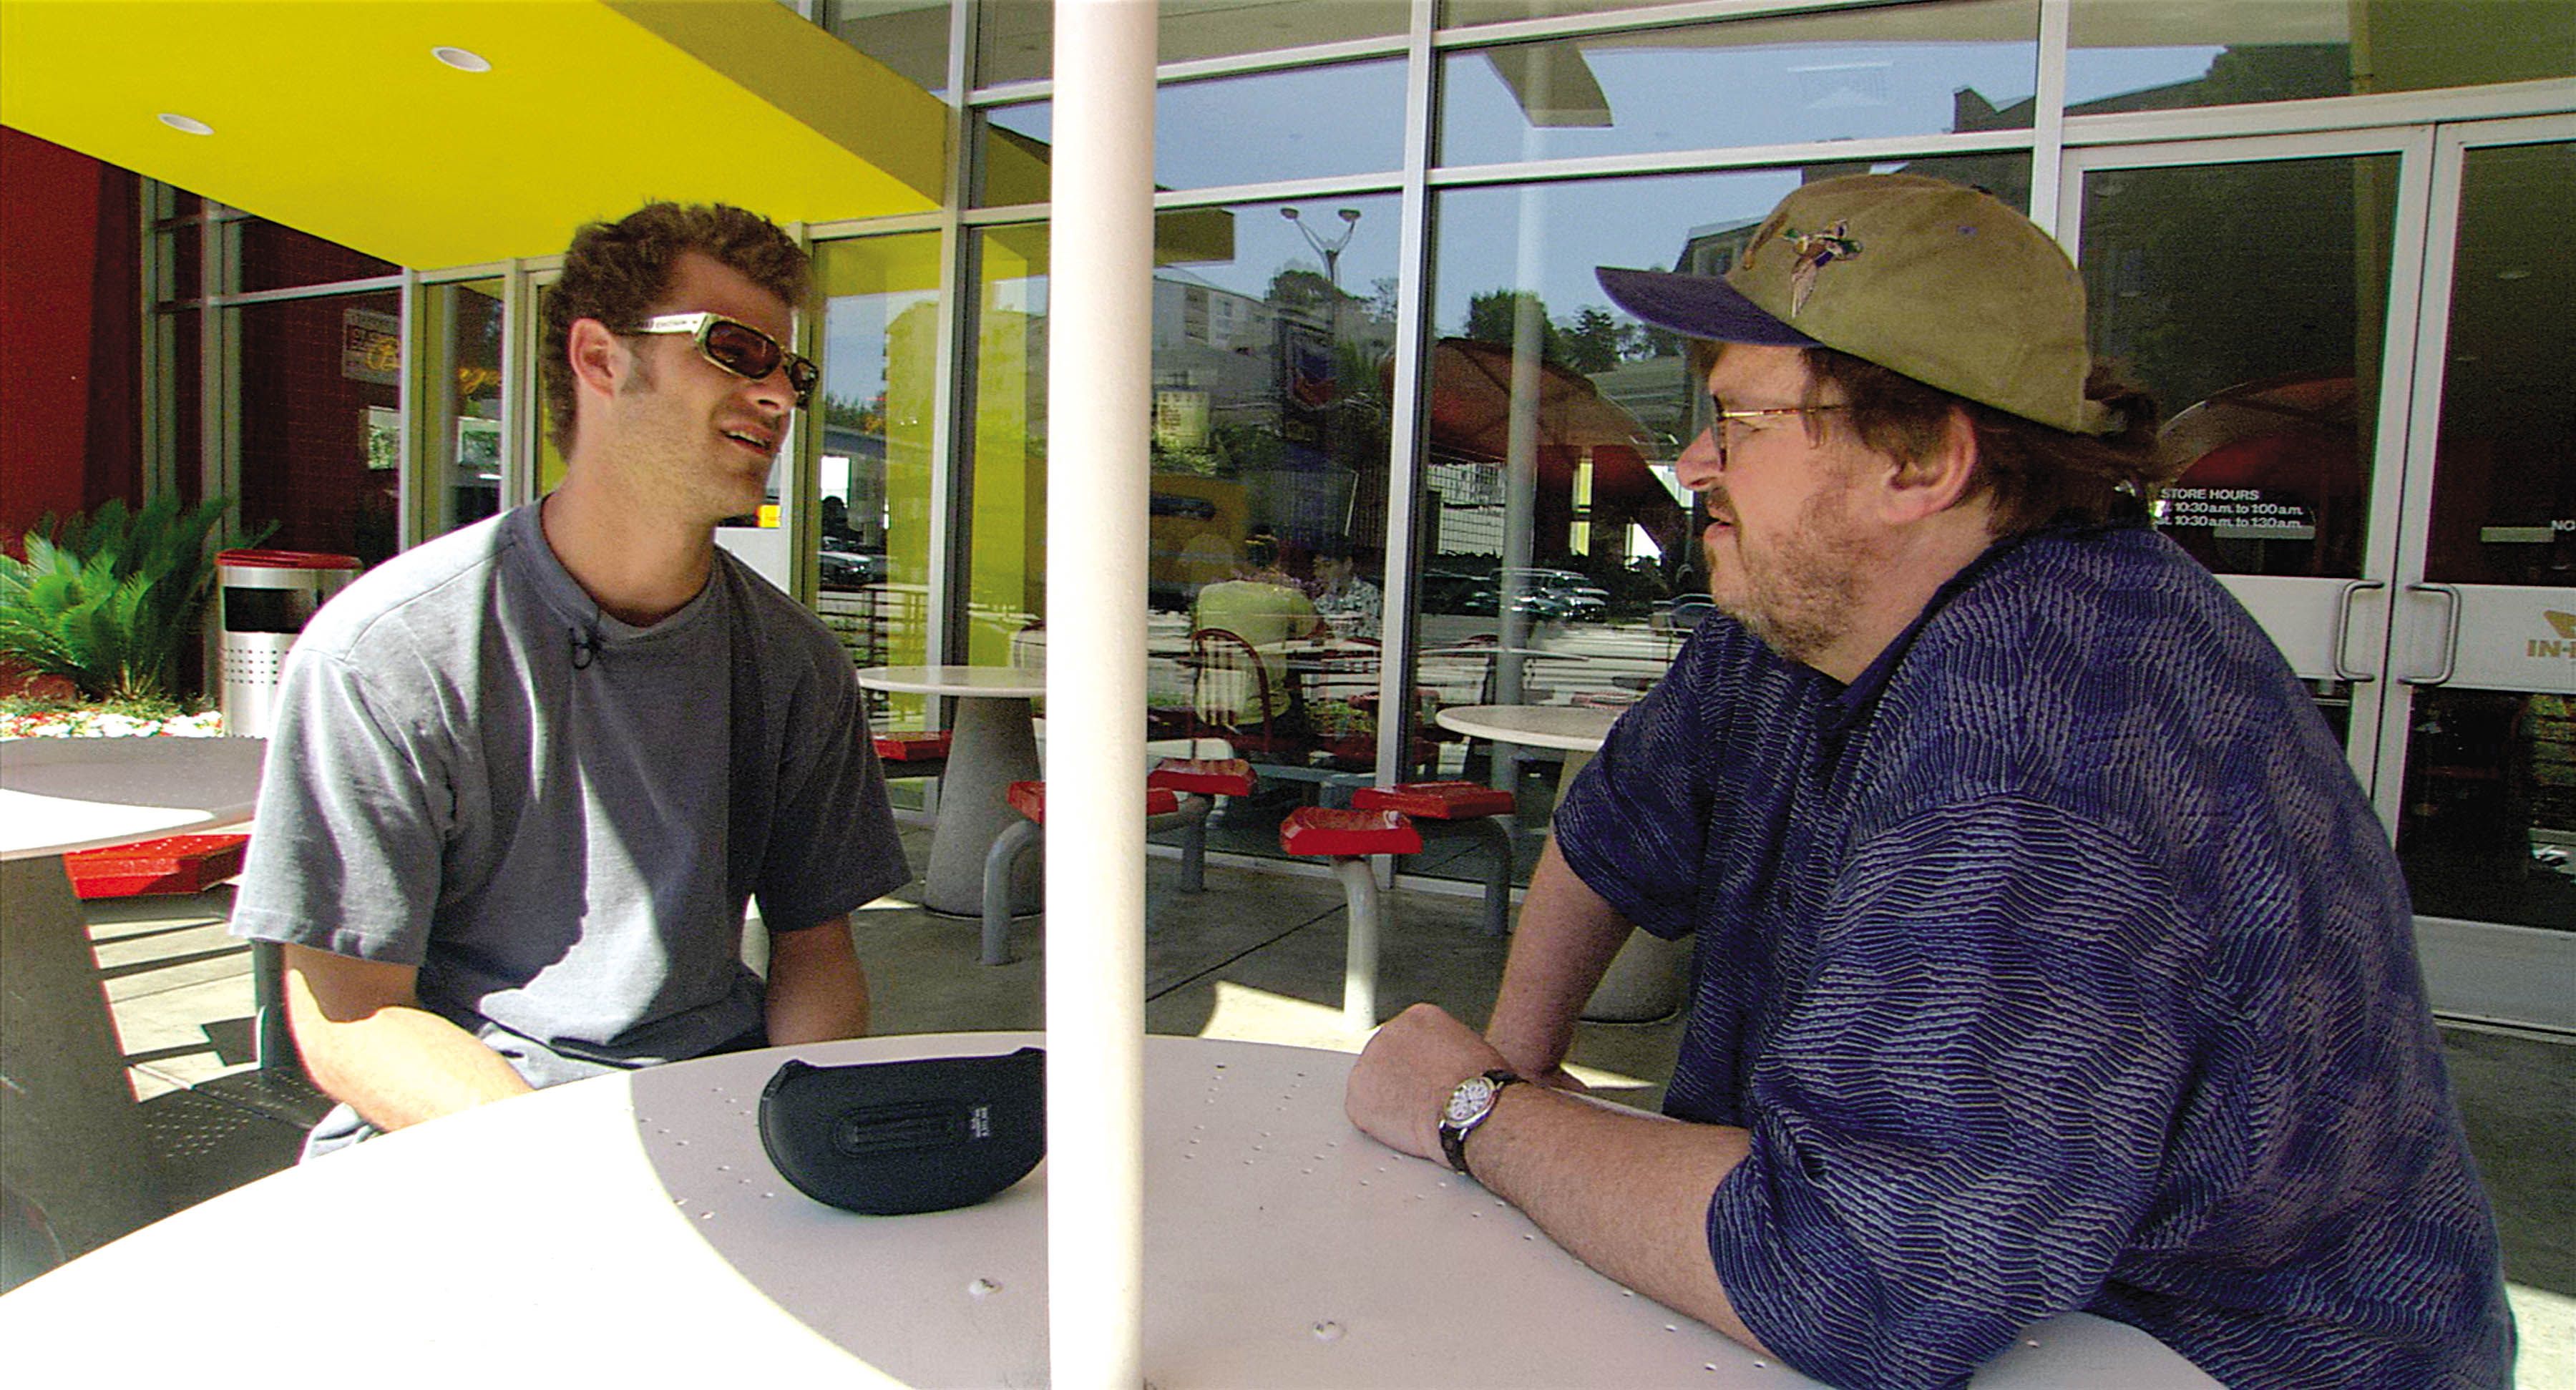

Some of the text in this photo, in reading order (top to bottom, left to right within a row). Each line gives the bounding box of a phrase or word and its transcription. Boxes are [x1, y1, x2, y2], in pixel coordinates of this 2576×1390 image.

[2161, 489, 2260, 501] STORE HOURS
[2235, 502, 2250, 514] to
[2235, 516, 2250, 527] to
